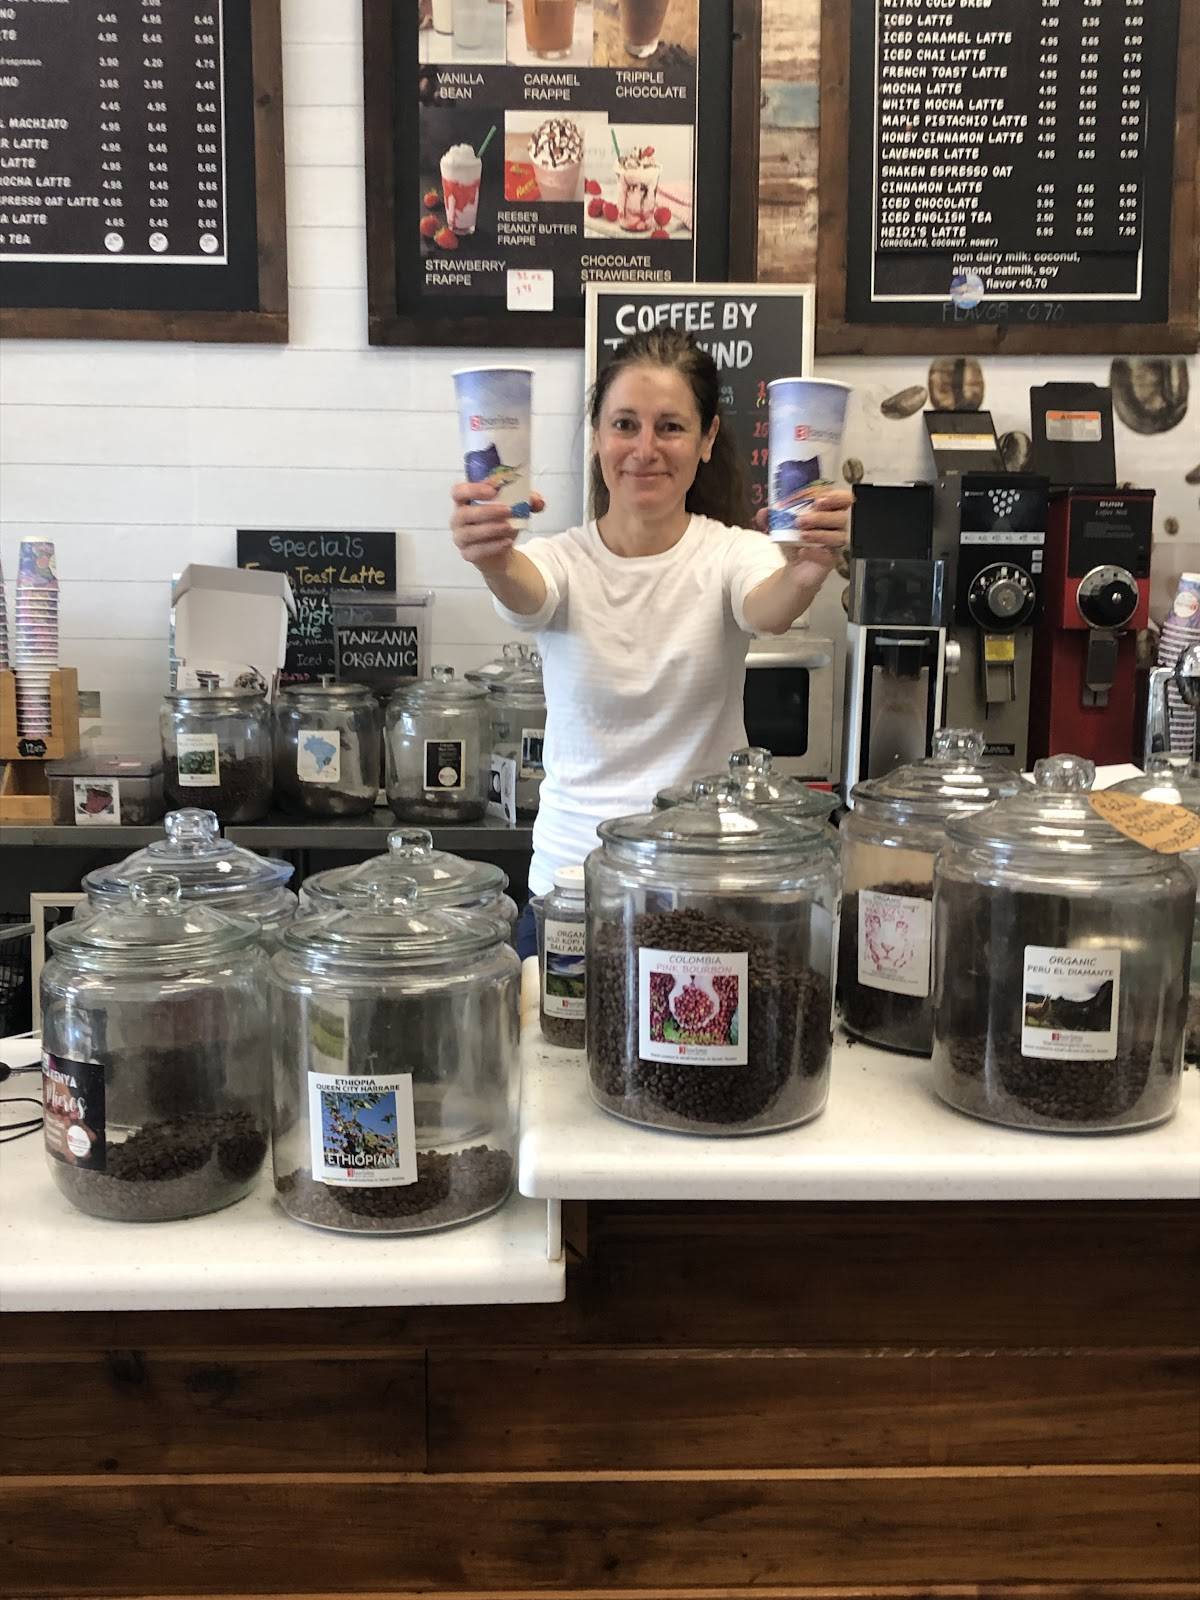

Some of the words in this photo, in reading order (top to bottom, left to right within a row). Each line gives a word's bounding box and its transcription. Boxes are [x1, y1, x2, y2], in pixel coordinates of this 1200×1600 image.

[884, 14, 912, 27] ICED
[917, 15, 952, 26] LATTE
[884, 32, 912, 43] ICED
[917, 32, 971, 43] CARAMEL
[977, 32, 1011, 44] LATTE
[884, 49, 912, 60] ICED
[917, 49, 945, 61] CHAI
[951, 49, 986, 61] LATTE
[616, 72, 664, 83] TRIPPLE
[883, 66, 926, 78] FRENCH
[932, 66, 967, 78] TOAST
[972, 67, 1007, 78] LATTE
[437, 73, 484, 84] VANILLA
[524, 74, 580, 86] CARAMEL
[440, 88, 472, 98] BEAN
[524, 88, 570, 100] FRAPPE
[616, 87, 686, 98] CHOCOLATE
[883, 83, 921, 94] MOCHA
[927, 83, 961, 94] LATTE
[883, 99, 919, 110] WHITE
[925, 99, 963, 110] MOCHA
[969, 99, 1003, 110] LATTE
[9, 118, 68, 129] MACHIATO
[883, 115, 919, 127] MAPLE
[925, 115, 988, 126] PISTACHIO
[993, 115, 1027, 126] LATTE
[882, 132, 918, 143] HONEY
[922, 132, 984, 143] CINNAMON
[989, 132, 1023, 143] LATTE
[14, 139, 48, 149] LATTE
[882, 148, 938, 159] LAVENDER
[944, 148, 979, 159] LATTE
[1, 158, 36, 168] LATTE
[882, 166, 925, 177] SHAKEN
[930, 166, 988, 177] ESPRESSO
[993, 166, 1013, 177] OAT
[36, 177, 71, 187] LATTE
[882, 182, 942, 193] CINNAMON
[948, 182, 982, 193] LATTE
[45, 197, 64, 206] OAT
[67, 197, 99, 207] LATTE
[882, 197, 910, 209] ICED
[915, 197, 978, 209] CHOCOLATE
[12, 214, 46, 224] LATTE
[498, 212, 538, 222] REESE'S
[882, 212, 910, 223] ICED
[915, 212, 965, 223] ENGLISH
[971, 212, 991, 223] TEA
[498, 224, 536, 234] PEANUT
[539, 224, 577, 234] BUTTER
[881, 226, 927, 238] HEIDI'S
[932, 226, 966, 237] LATTE
[9, 234, 30, 244] TEA
[498, 236, 536, 246] FRAPPE
[581, 256, 650, 267] CHOCOLATE
[953, 253, 973, 262] non
[976, 252, 1002, 264] dairy
[1034, 252, 1080, 263] coconut,
[426, 260, 506, 272] STRAWBERRY
[953, 266, 992, 276] almond
[995, 266, 1036, 276] oatmilk,
[1039, 267, 1059, 277] soy
[426, 274, 471, 286] FRAPPE
[581, 270, 671, 281] STRAWBERRIES
[986, 278, 1016, 289] flavor
[1019, 279, 1048, 289] +0.70
[616, 302, 715, 335] COFFEE
[723, 303, 757, 330] BY
[269, 536, 364, 557] Specials
[296, 566, 336, 584] Toast
[340, 566, 385, 585] Latte
[339, 630, 417, 646] TANZANIA
[342, 651, 417, 668] ORGANIC
[669, 955, 721, 964] COLOMBIA
[1049, 956, 1097, 966] ORGANIC
[657, 964, 678, 972] PINK
[682, 966, 732, 974] BOURBON
[1027, 966, 1051, 974] PERU
[1068, 968, 1114, 976] DIAMANTE
[328, 1154, 396, 1166] ETHIOPIAN
